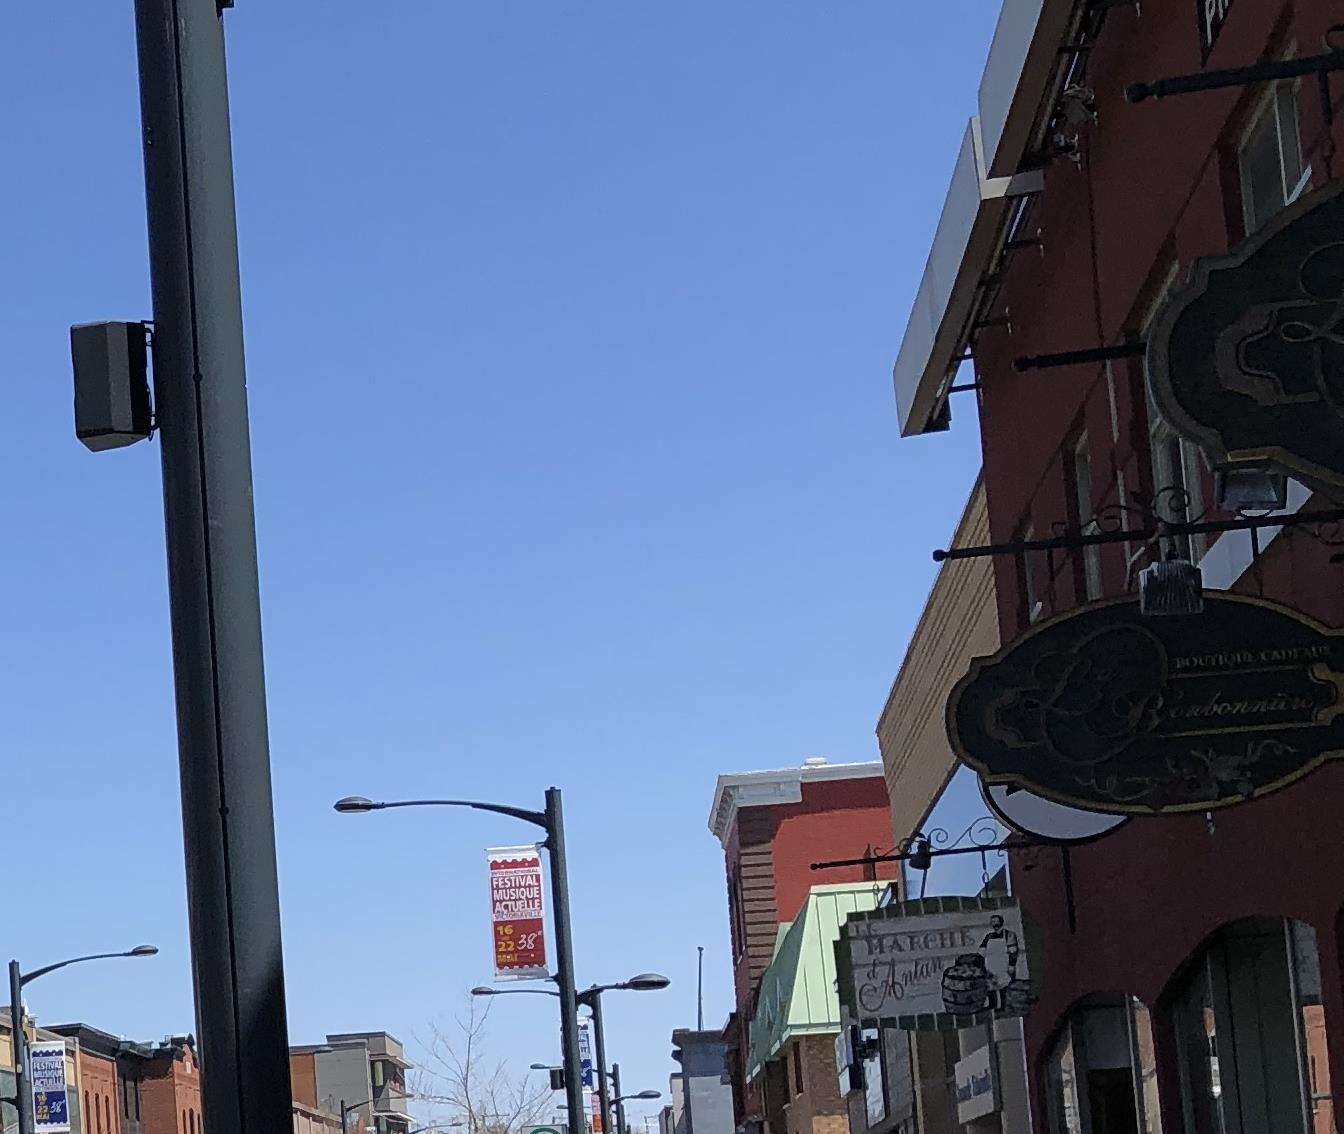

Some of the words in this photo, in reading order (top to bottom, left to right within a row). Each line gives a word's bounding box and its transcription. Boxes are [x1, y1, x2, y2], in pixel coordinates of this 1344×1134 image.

[493, 875, 539, 889] FESTIVAL
[493, 887, 540, 901] MUSIQUE
[494, 899, 541, 913] ACTUELLE
[496, 925, 513, 936] 16
[498, 941, 515, 952] 22
